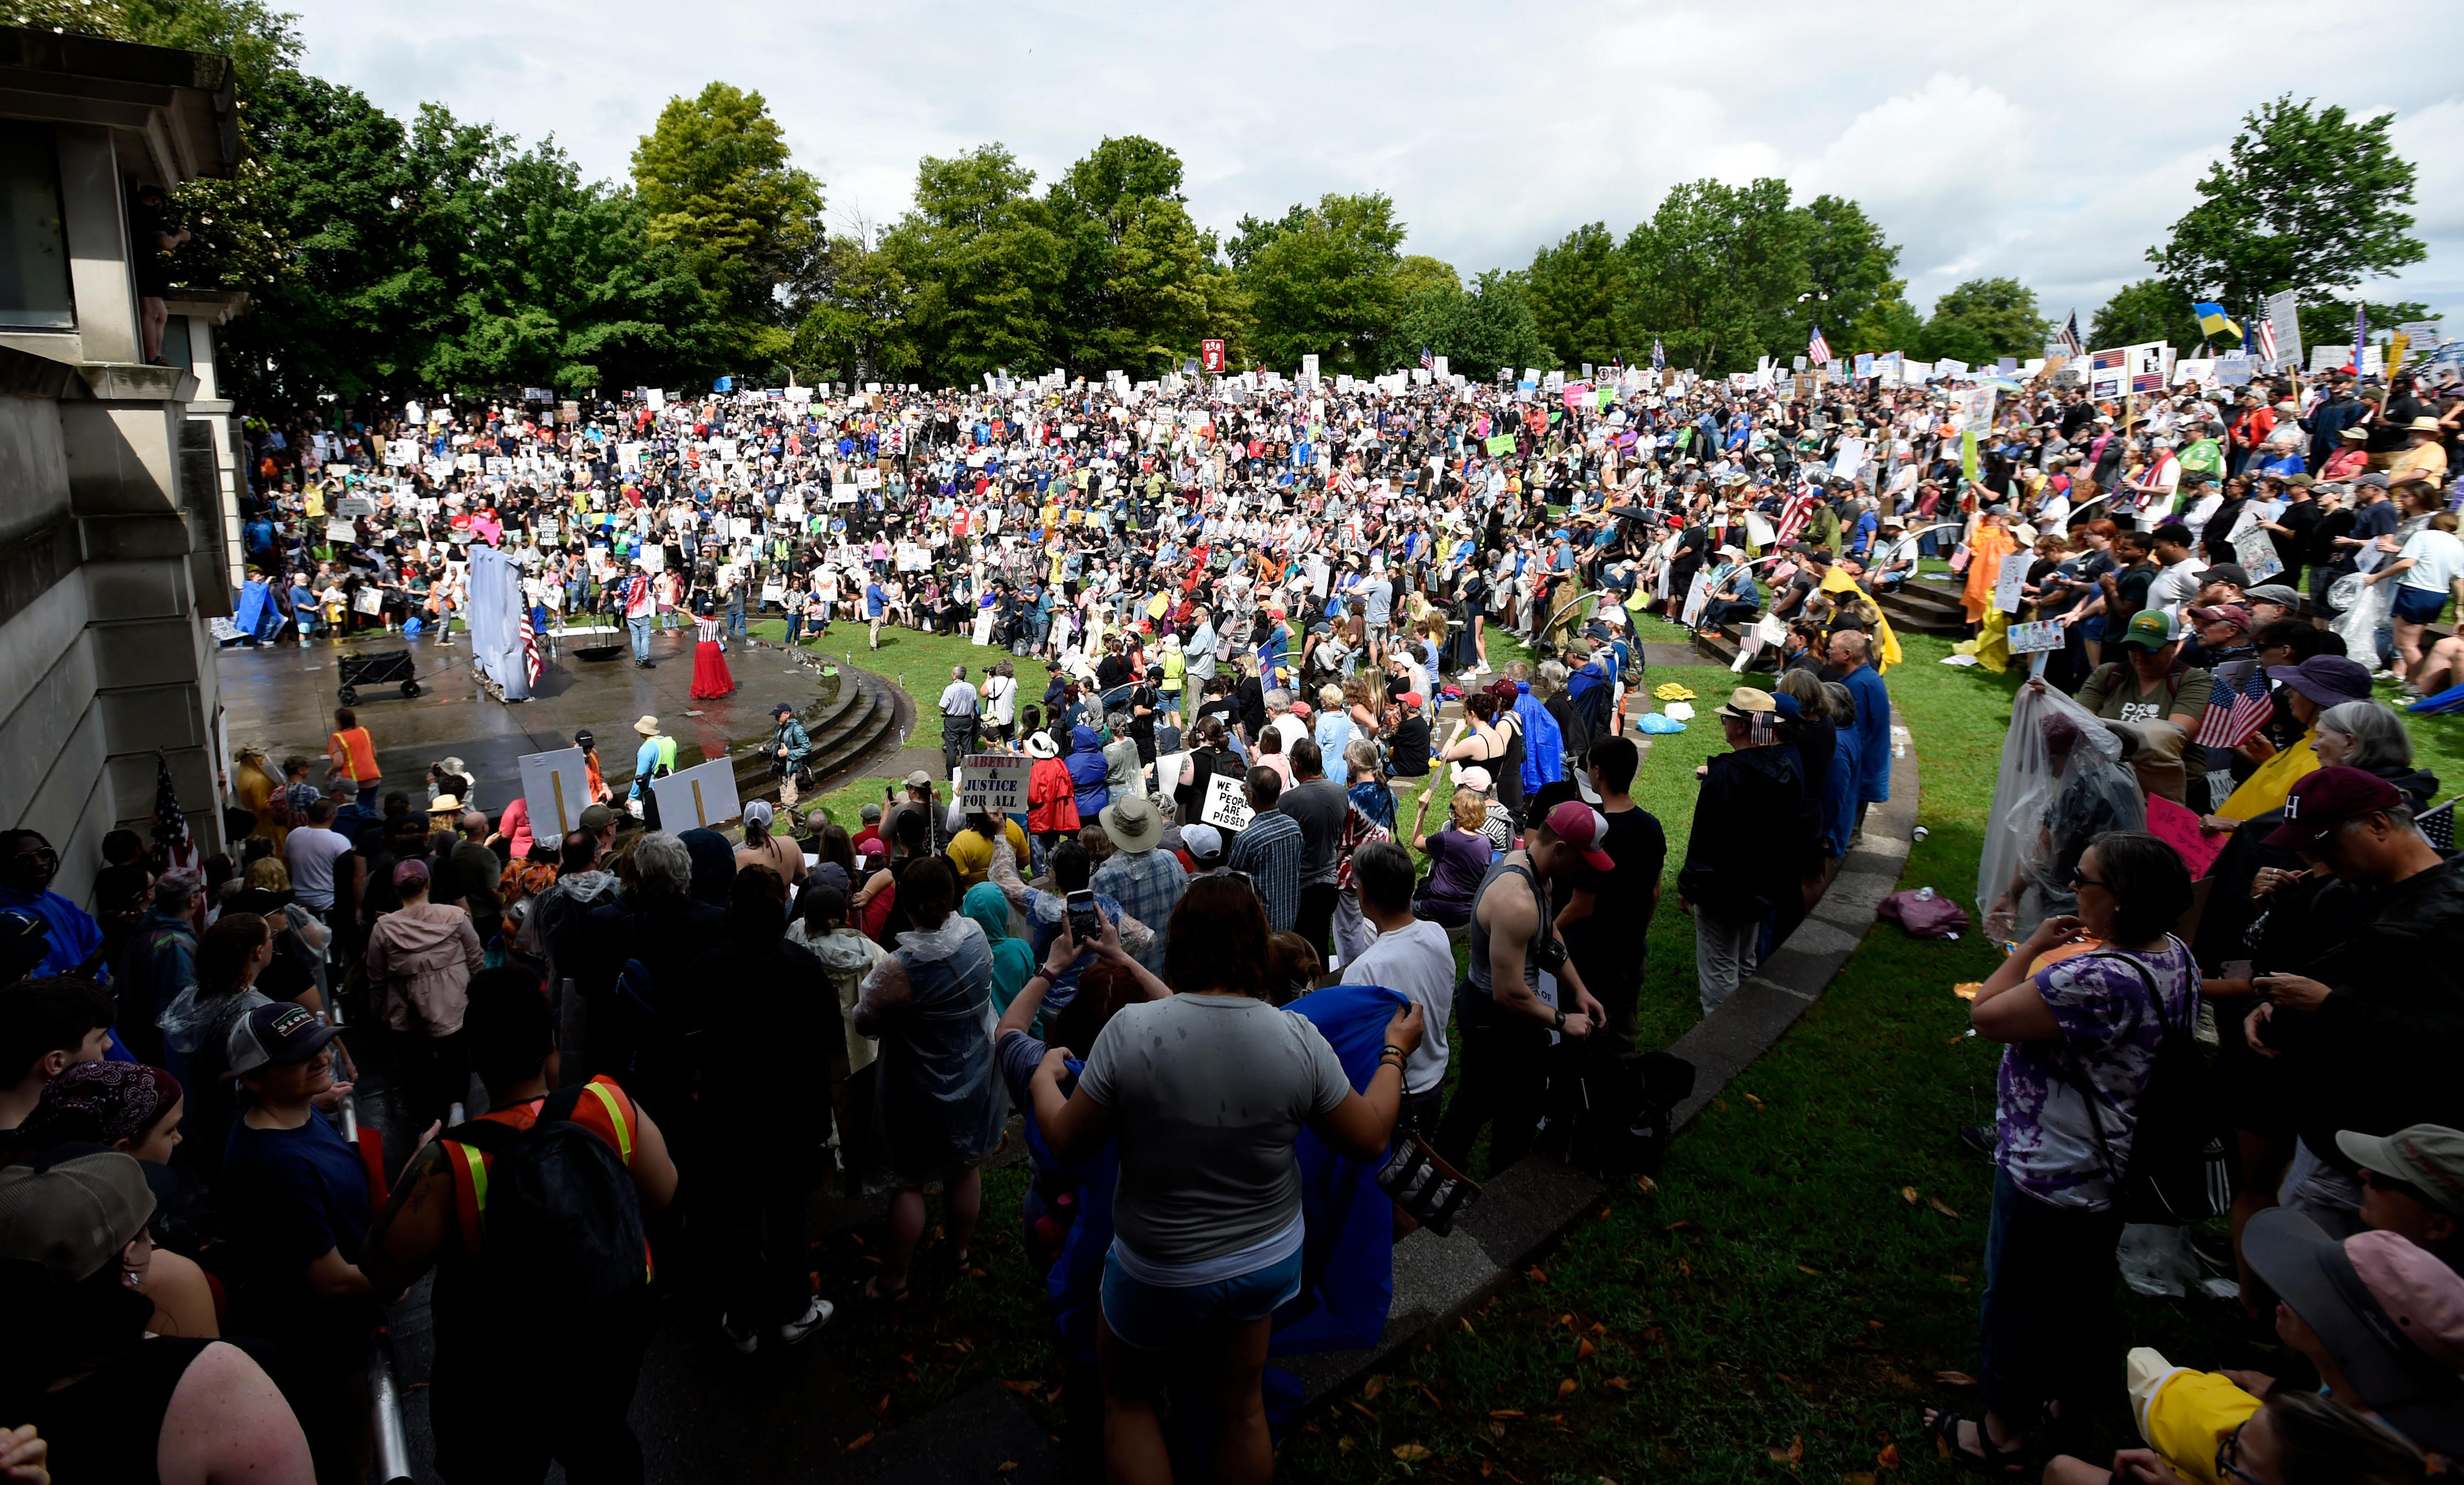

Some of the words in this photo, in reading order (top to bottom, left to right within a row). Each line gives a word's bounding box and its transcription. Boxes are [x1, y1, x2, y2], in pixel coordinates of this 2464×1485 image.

[964, 756, 1023, 769] LIBERTY
[989, 768, 998, 779] &
[964, 780, 1018, 792] JUSTICE
[1217, 780, 1232, 792] WE
[963, 795, 987, 807] FOR
[993, 795, 1017, 807] ALL
[1219, 792, 1248, 809] PEOPLE
[1223, 804, 1241, 816] ARE
[2284, 795, 2300, 819] H
[1213, 812, 1245, 828] PISSED
